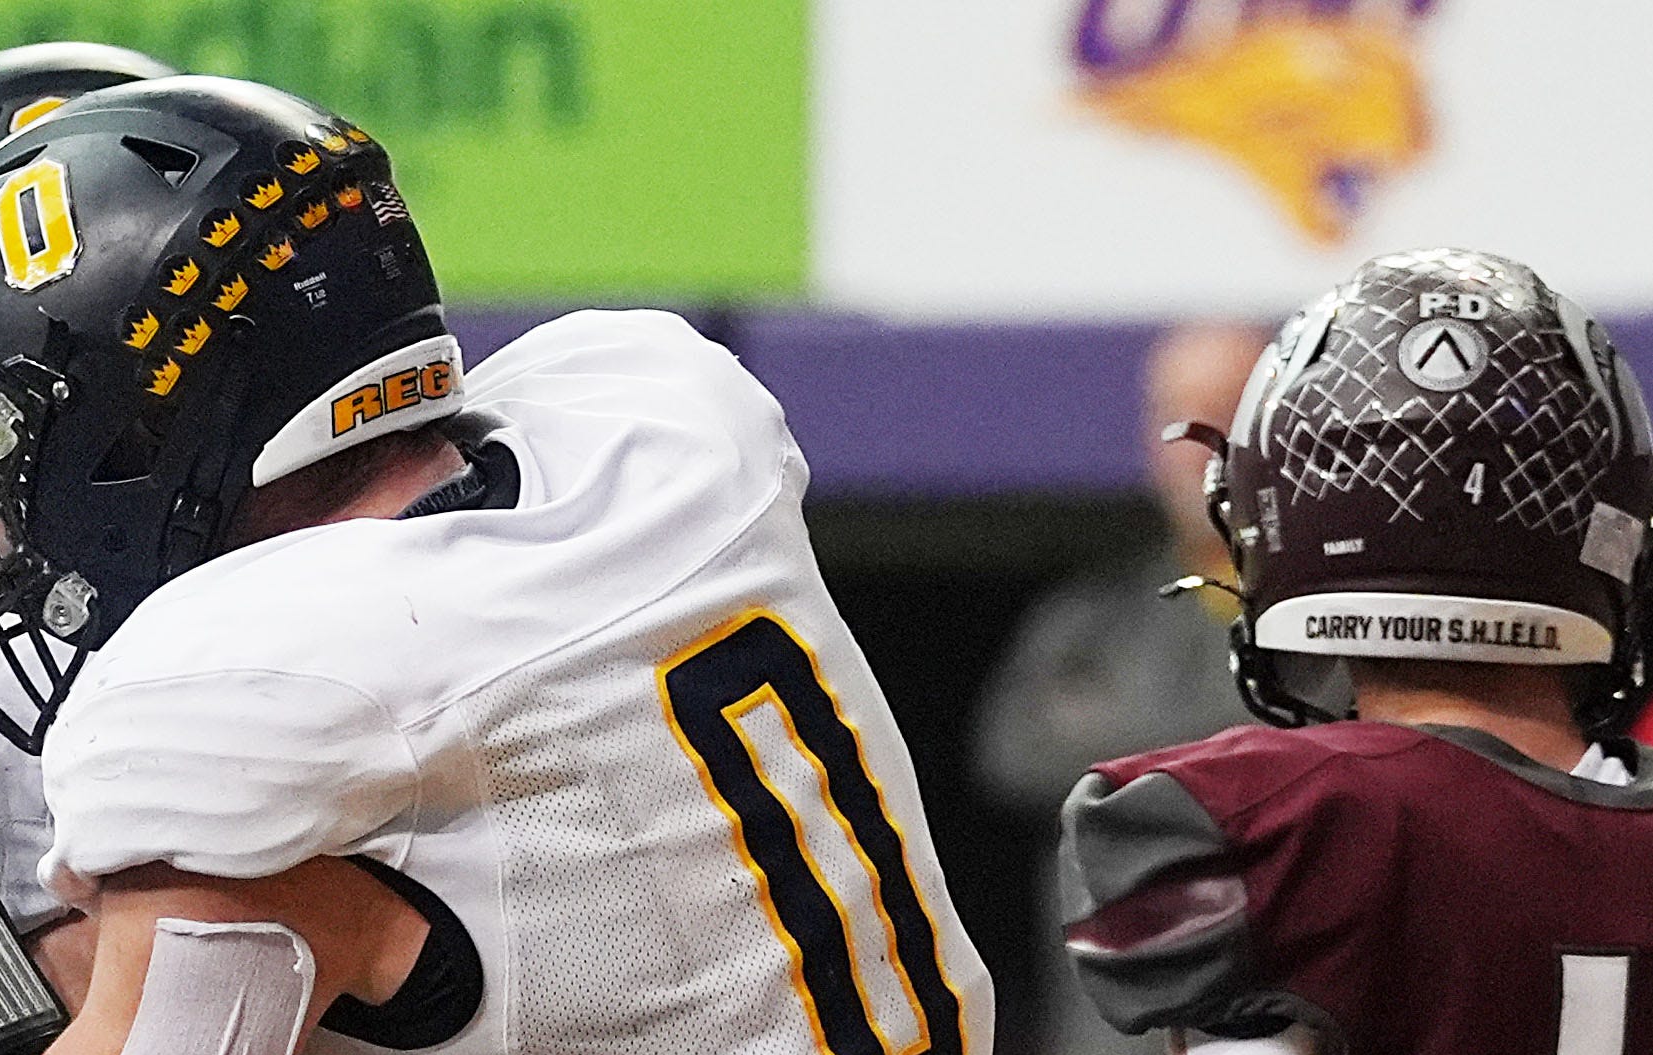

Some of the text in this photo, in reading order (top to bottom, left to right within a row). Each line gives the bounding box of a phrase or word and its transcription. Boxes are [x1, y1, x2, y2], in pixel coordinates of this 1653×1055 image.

[1463, 462, 1486, 505] 4
[1305, 615, 1373, 640] CARRY
[1379, 616, 1442, 643] YOUR
